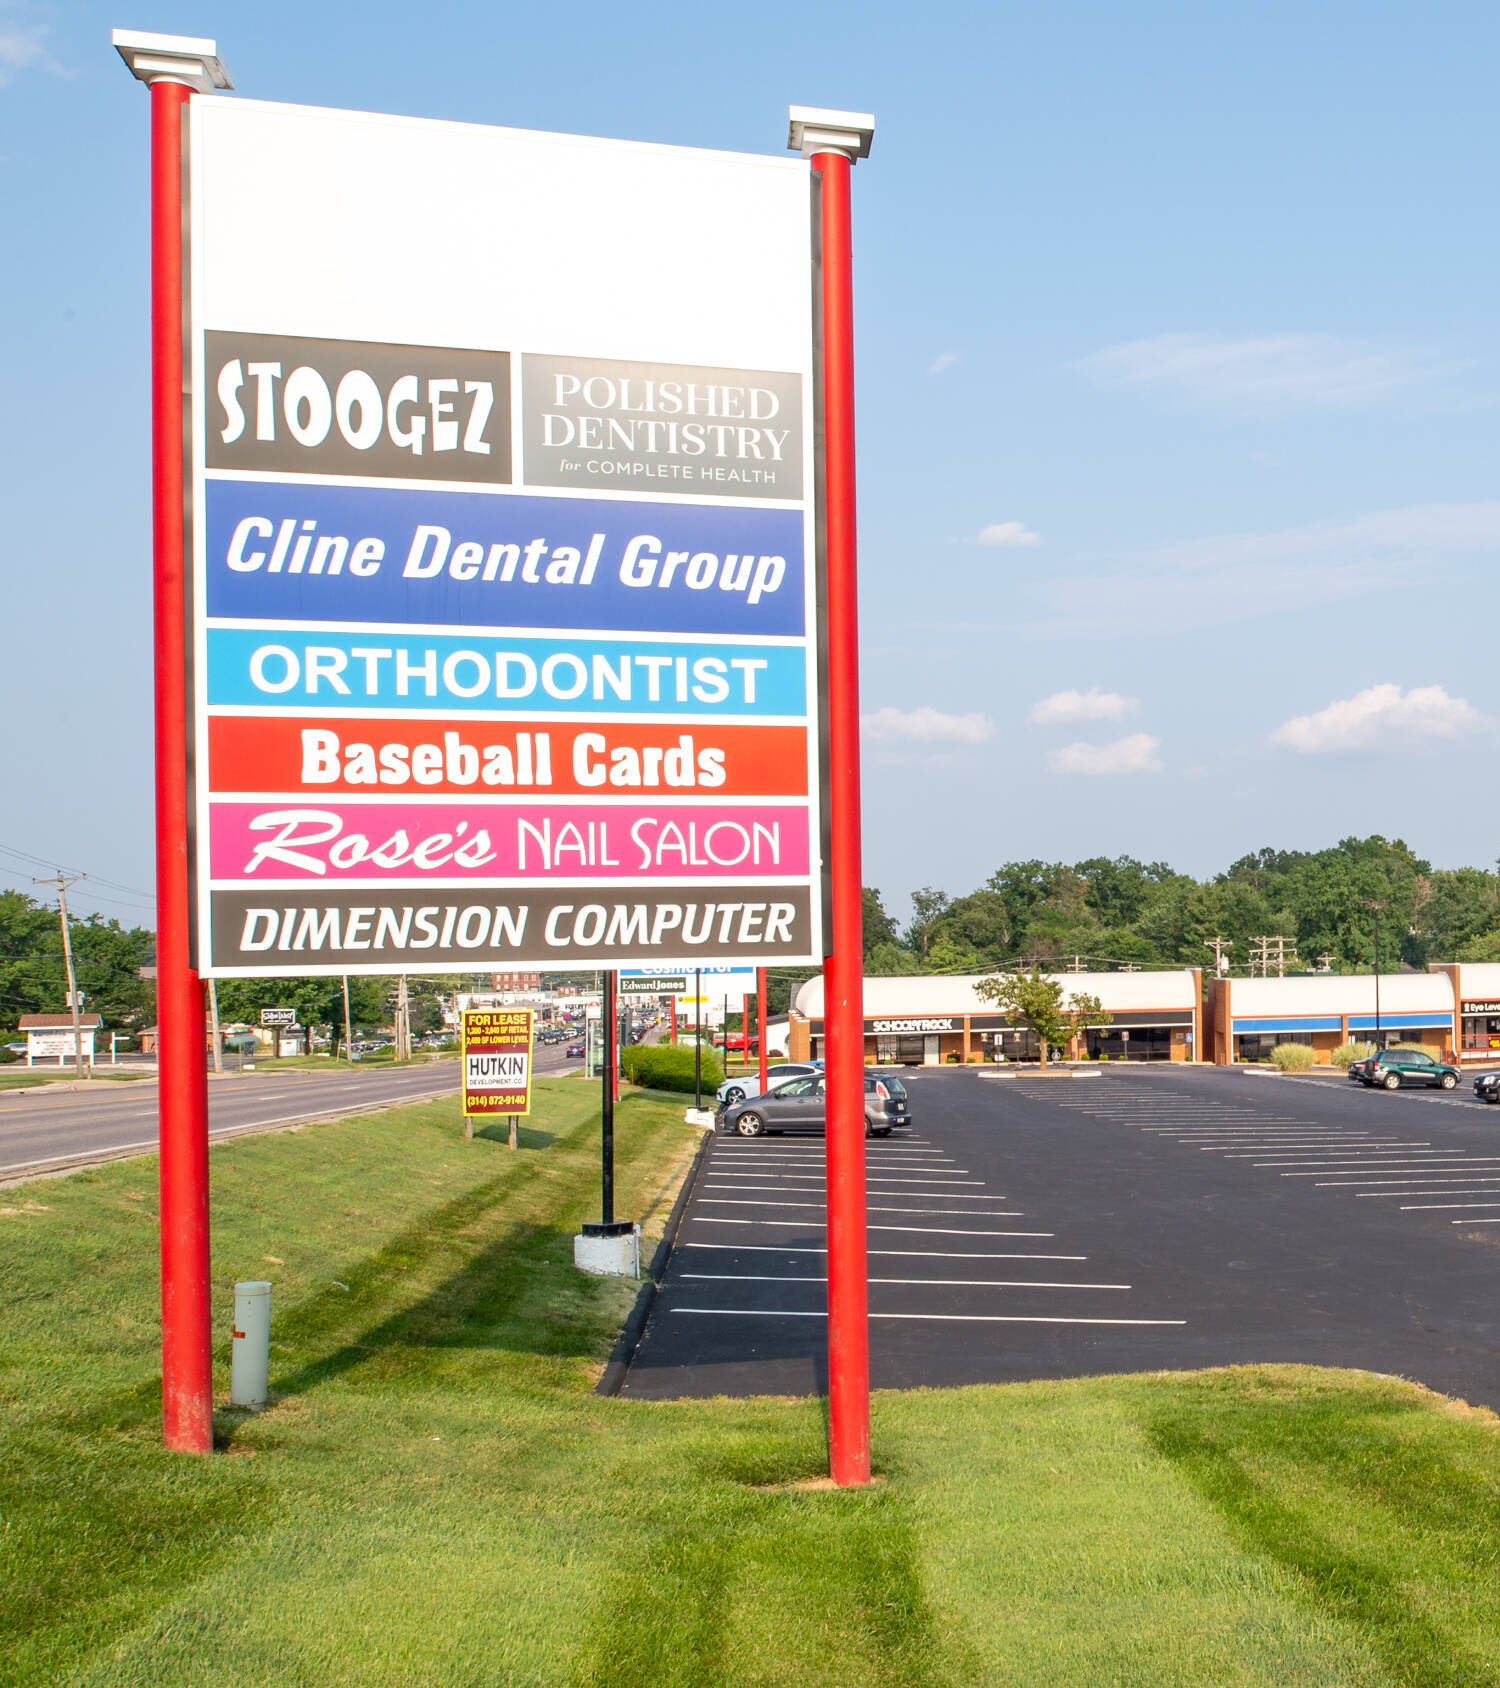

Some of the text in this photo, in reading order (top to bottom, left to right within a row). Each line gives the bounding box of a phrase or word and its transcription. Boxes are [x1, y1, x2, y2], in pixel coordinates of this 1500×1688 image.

[217, 358, 494, 456] STOOGEZ
[552, 373, 780, 421] POLISHED
[541, 413, 792, 461] DENTISTRY
[560, 458, 777, 485] for COMPLETE HEALTH
[226, 515, 787, 604] Cline Dental Group
[248, 644, 768, 704] ORTHODONTIST
[300, 728, 727, 788] Baseball Cards
[243, 808, 781, 876] Rose's NAIL SALON
[239, 901, 797, 952] DIMENSION COMPUTER
[469, 1014, 527, 1026] FOR LEASE
[873, 1020, 914, 1032] SCHOOL
[922, 1019, 953, 1030] ROCK
[1470, 1003, 1484, 1012] Eye
[490, 1036, 510, 1044] LOWER
[511, 1035, 528, 1043] LEVEL
[500, 1026, 508, 1034] SF
[509, 1026, 528, 1034] RETAIL
[470, 1057, 524, 1076] HUTKIN
[467, 1095, 526, 1108] (314) 872-9140
